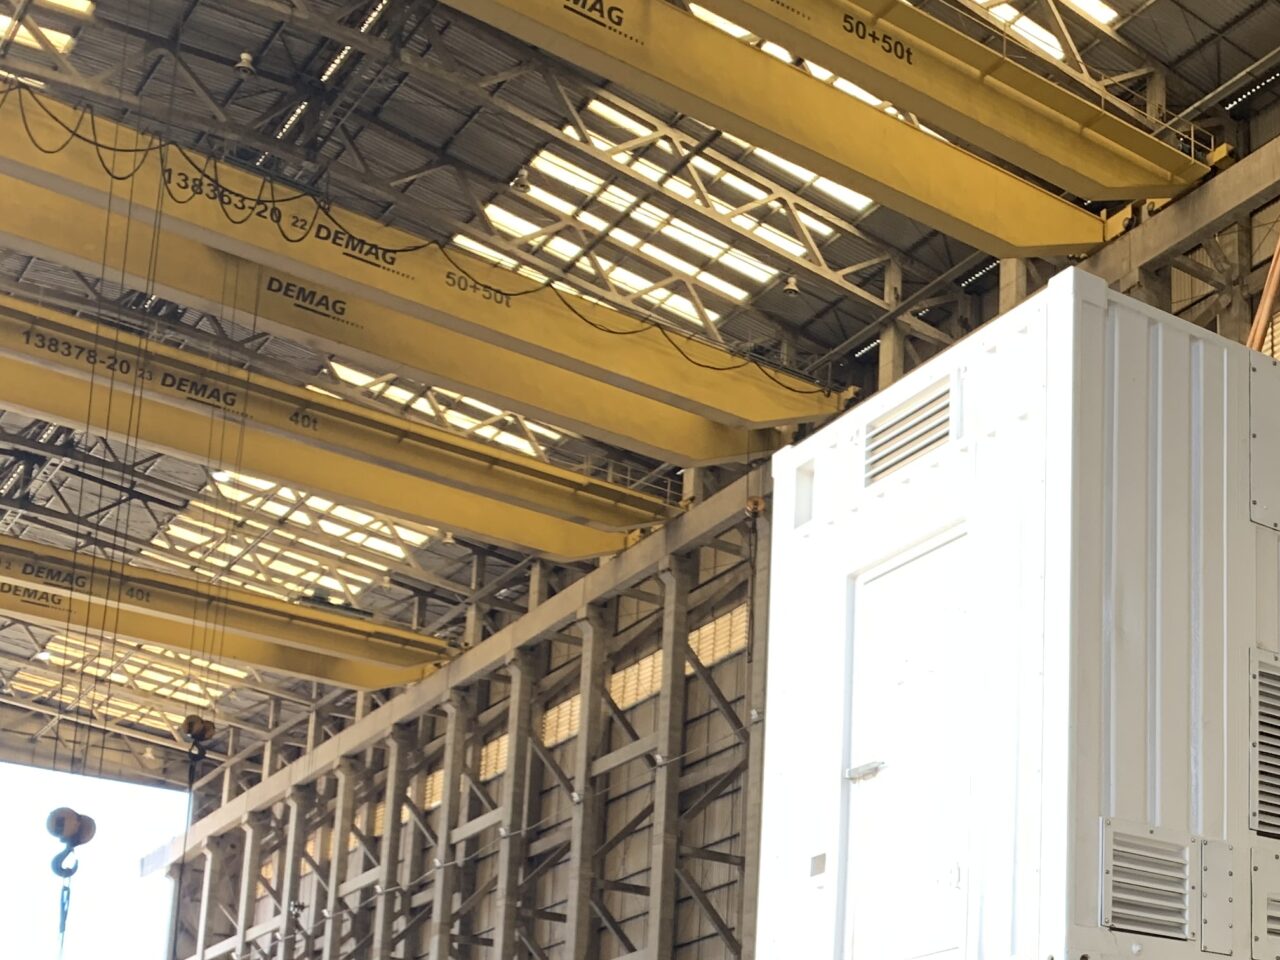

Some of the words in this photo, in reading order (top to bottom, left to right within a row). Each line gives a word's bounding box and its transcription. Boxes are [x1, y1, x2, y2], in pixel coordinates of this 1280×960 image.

[843, 13, 913, 65] 50+50t
[314, 223, 397, 266] DEMAG
[445, 271, 511, 308] 50+50t
[266, 276, 347, 317] DEMAG
[21, 329, 131, 375] 138378-20
[160, 372, 238, 407] DEMAG
[289, 410, 318, 431] 40t
[0, 582, 62, 606] DEMAG
[21, 562, 88, 588] DEMAG
